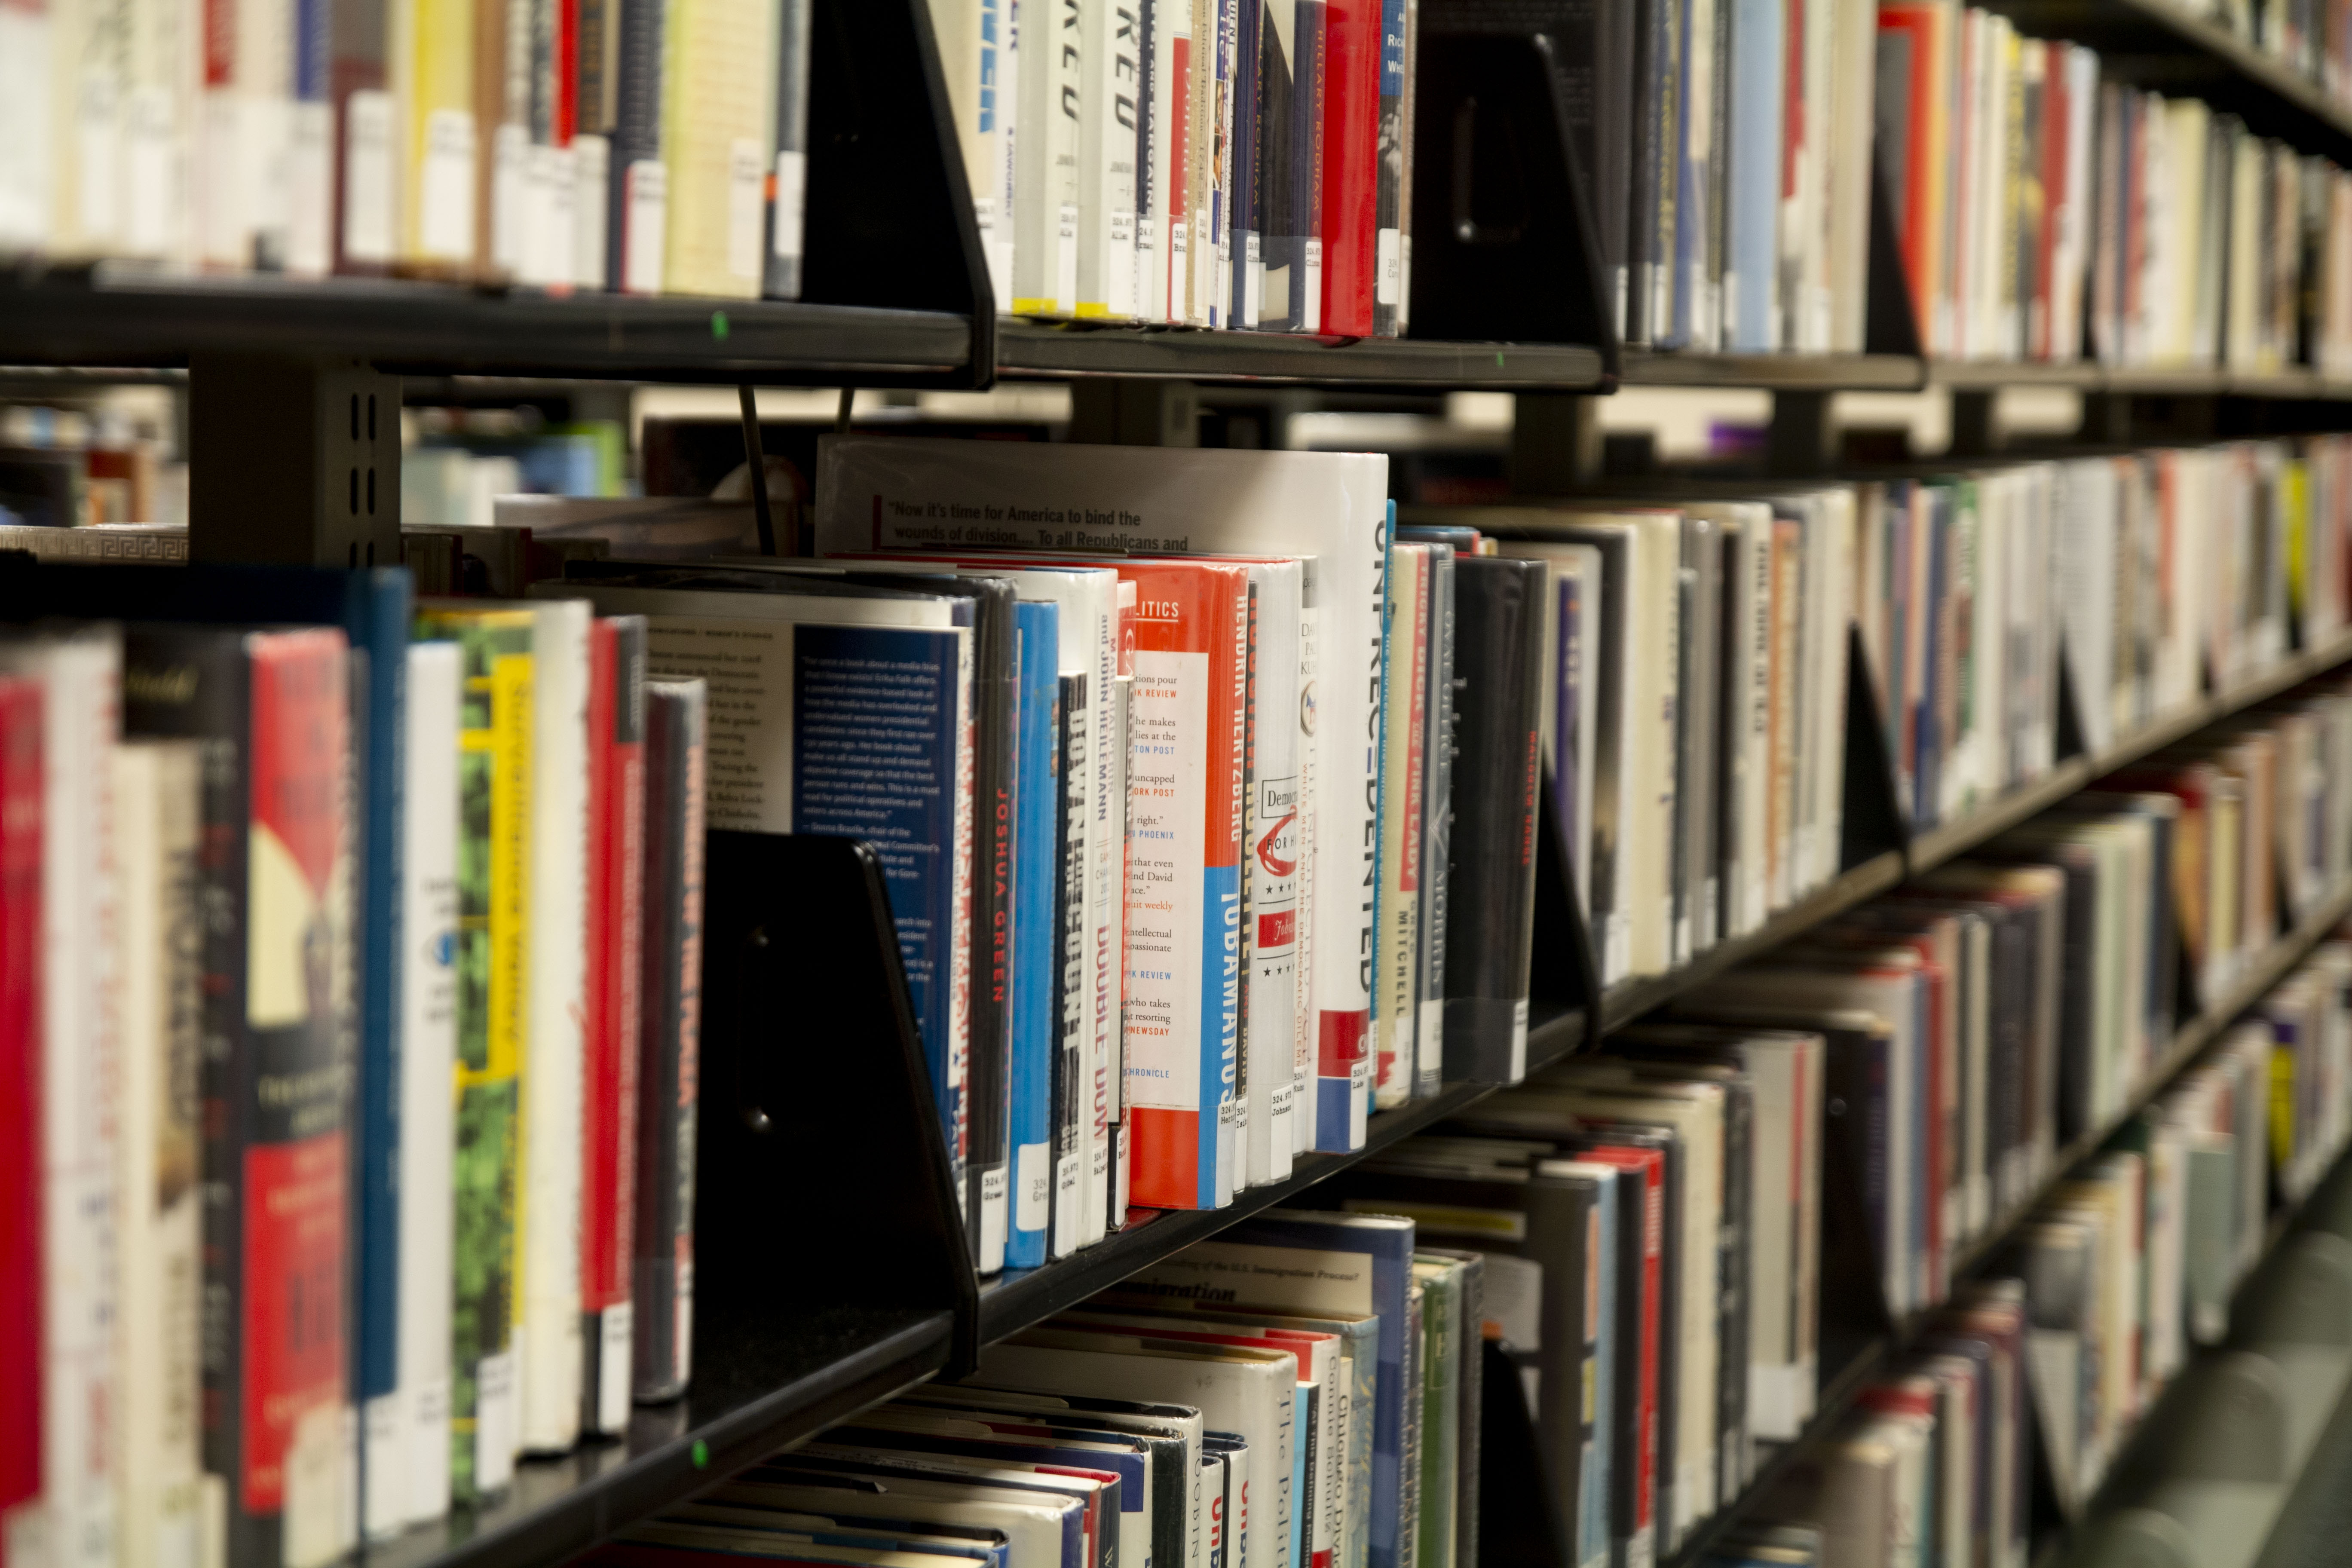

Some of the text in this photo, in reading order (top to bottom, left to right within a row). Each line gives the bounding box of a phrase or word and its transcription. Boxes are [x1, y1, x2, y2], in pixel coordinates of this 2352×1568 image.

[1313, 30, 1323, 210] HILLARY RODHAM
[950, 504, 980, 519] time
[984, 505, 1004, 520] for
[1008, 506, 1063, 524] America
[1067, 508, 1082, 524] to
[1085, 509, 1115, 526] bind
[1119, 510, 1141, 527] the
[895, 525, 945, 540] wounds
[949, 526, 963, 541] of
[1038, 530, 1053, 545] To
[1056, 530, 1072, 546] all
[1077, 531, 1158, 550] Republicans
[1162, 536, 1188, 551] and
[1418, 565, 1428, 636] TRICKY
[1109, 638, 1117, 693] MARK
[1157, 676, 1177, 686] pour
[1415, 646, 1426, 712] DICK
[1146, 689, 1177, 698] REVIEW
[1098, 614, 1110, 821] and JOHN HEILEMANN
[1149, 717, 1176, 727] makes
[1231, 595, 1246, 842] HENDRIK HERTZBERG
[1439, 682, 1451, 769] OFFICE
[1162, 732, 1176, 741] the
[1154, 746, 1174, 755] POST
[1135, 774, 1175, 786] uncapped
[1411, 756, 1422, 806] PINK
[1153, 788, 1174, 797] POST
[1139, 830, 1174, 839] PHOENIX
[1407, 814, 1420, 879] LADY
[1134, 857, 1151, 867] that
[1130, 871, 1173, 882] nd David
[993, 787, 1008, 1002] JOSHUA GREEN
[1145, 900, 1173, 913] weekly
[1395, 910, 1409, 1016] MITCHELL
[1140, 970, 1171, 980] REVIEW
[1095, 923, 1111, 1056] DOUBLE
[1150, 998, 1171, 1008] takes
[1135, 1013, 1171, 1025] resorting
[1130, 1026, 1170, 1036] NEWSDAY
[1130, 1068, 1170, 1078] HRONICLE
[1272, 1104, 1292, 1117] Johnson
[1253, 1265, 1314, 1278] Immigration
[1317, 1269, 1359, 1281] Process?
[1278, 1390, 1292, 1461] The
[1324, 1356, 1337, 1534] Connie Schultz
[1334, 1394, 1349, 1500] Chicago
[1191, 1444, 1202, 1559] TOOBIN
